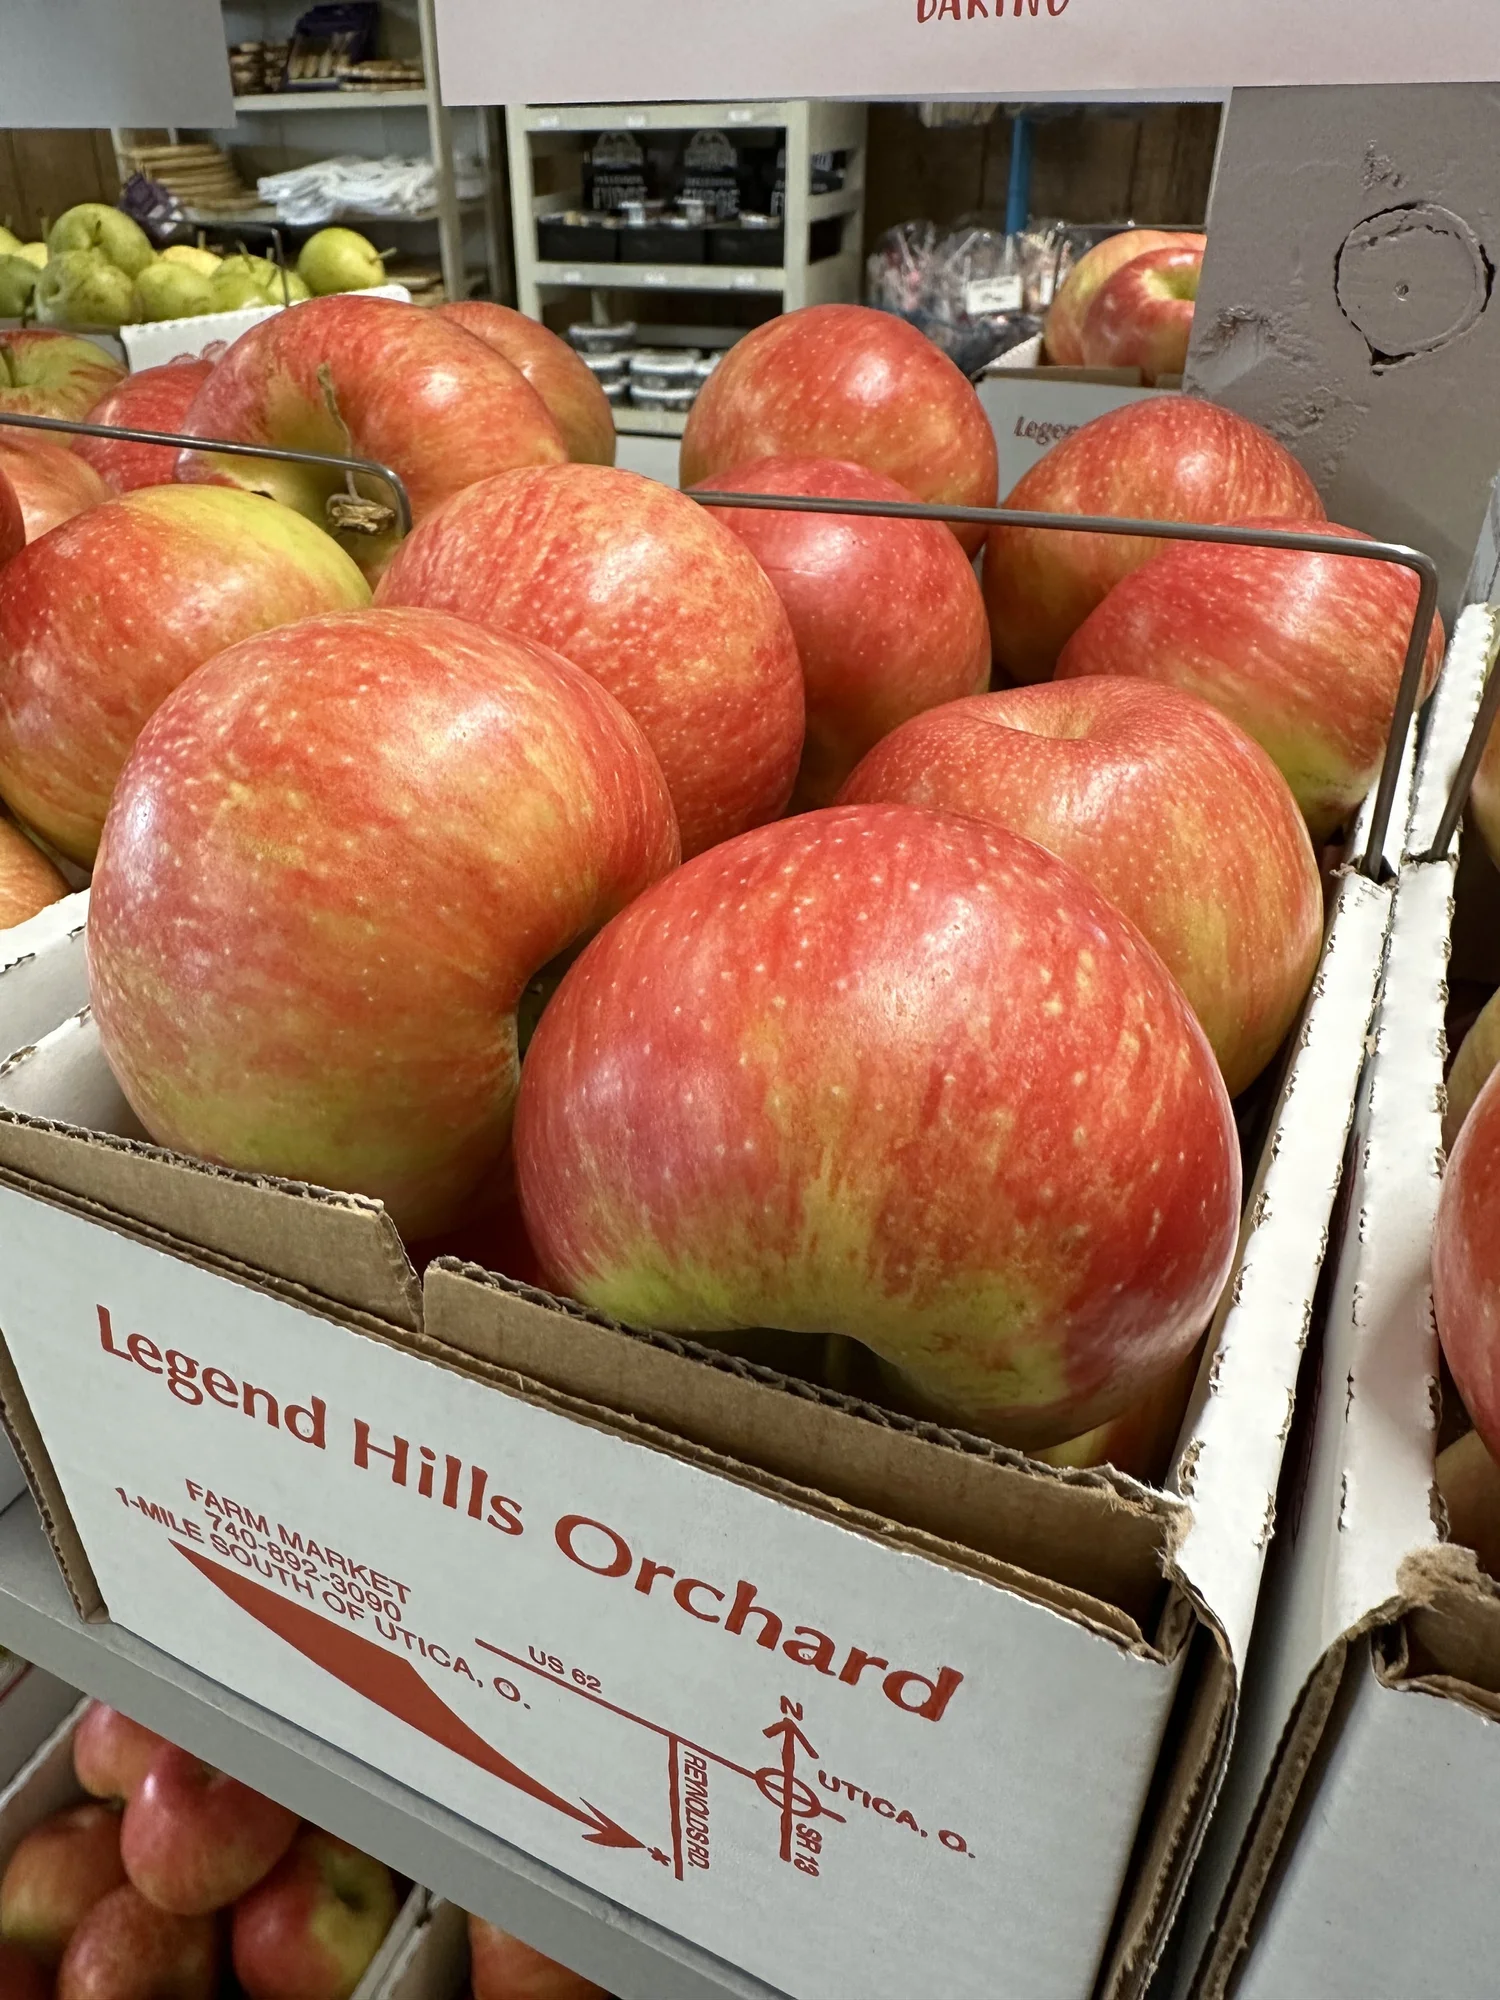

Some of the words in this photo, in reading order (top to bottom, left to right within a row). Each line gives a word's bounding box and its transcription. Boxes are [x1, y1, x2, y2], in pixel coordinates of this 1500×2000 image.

[1013, 415, 1080, 445] Lege
[96, 1303, 327, 1450] Legend
[353, 1417, 525, 1537] Hills
[553, 1513, 965, 1722] Orchard
[185, 1478, 271, 1537] FARM
[277, 1523, 411, 1605] MARKET
[115, 1487, 205, 1544] 1-MILE
[210, 1533, 315, 1600] SOUTH
[322, 1590, 365, 1621] OF
[374, 1615, 484, 1688] UTICA,
[493, 1677, 531, 1709] O.
[204, 1509, 402, 1623] 740-892-3090
[528, 1645, 565, 1675] US
[571, 1667, 603, 1693] 62
[684, 1751, 710, 1845] REYNOLDS
[688, 1838, 710, 1870] RD.
[795, 1823, 823, 1855] SR
[938, 1829, 976, 1859] O.
